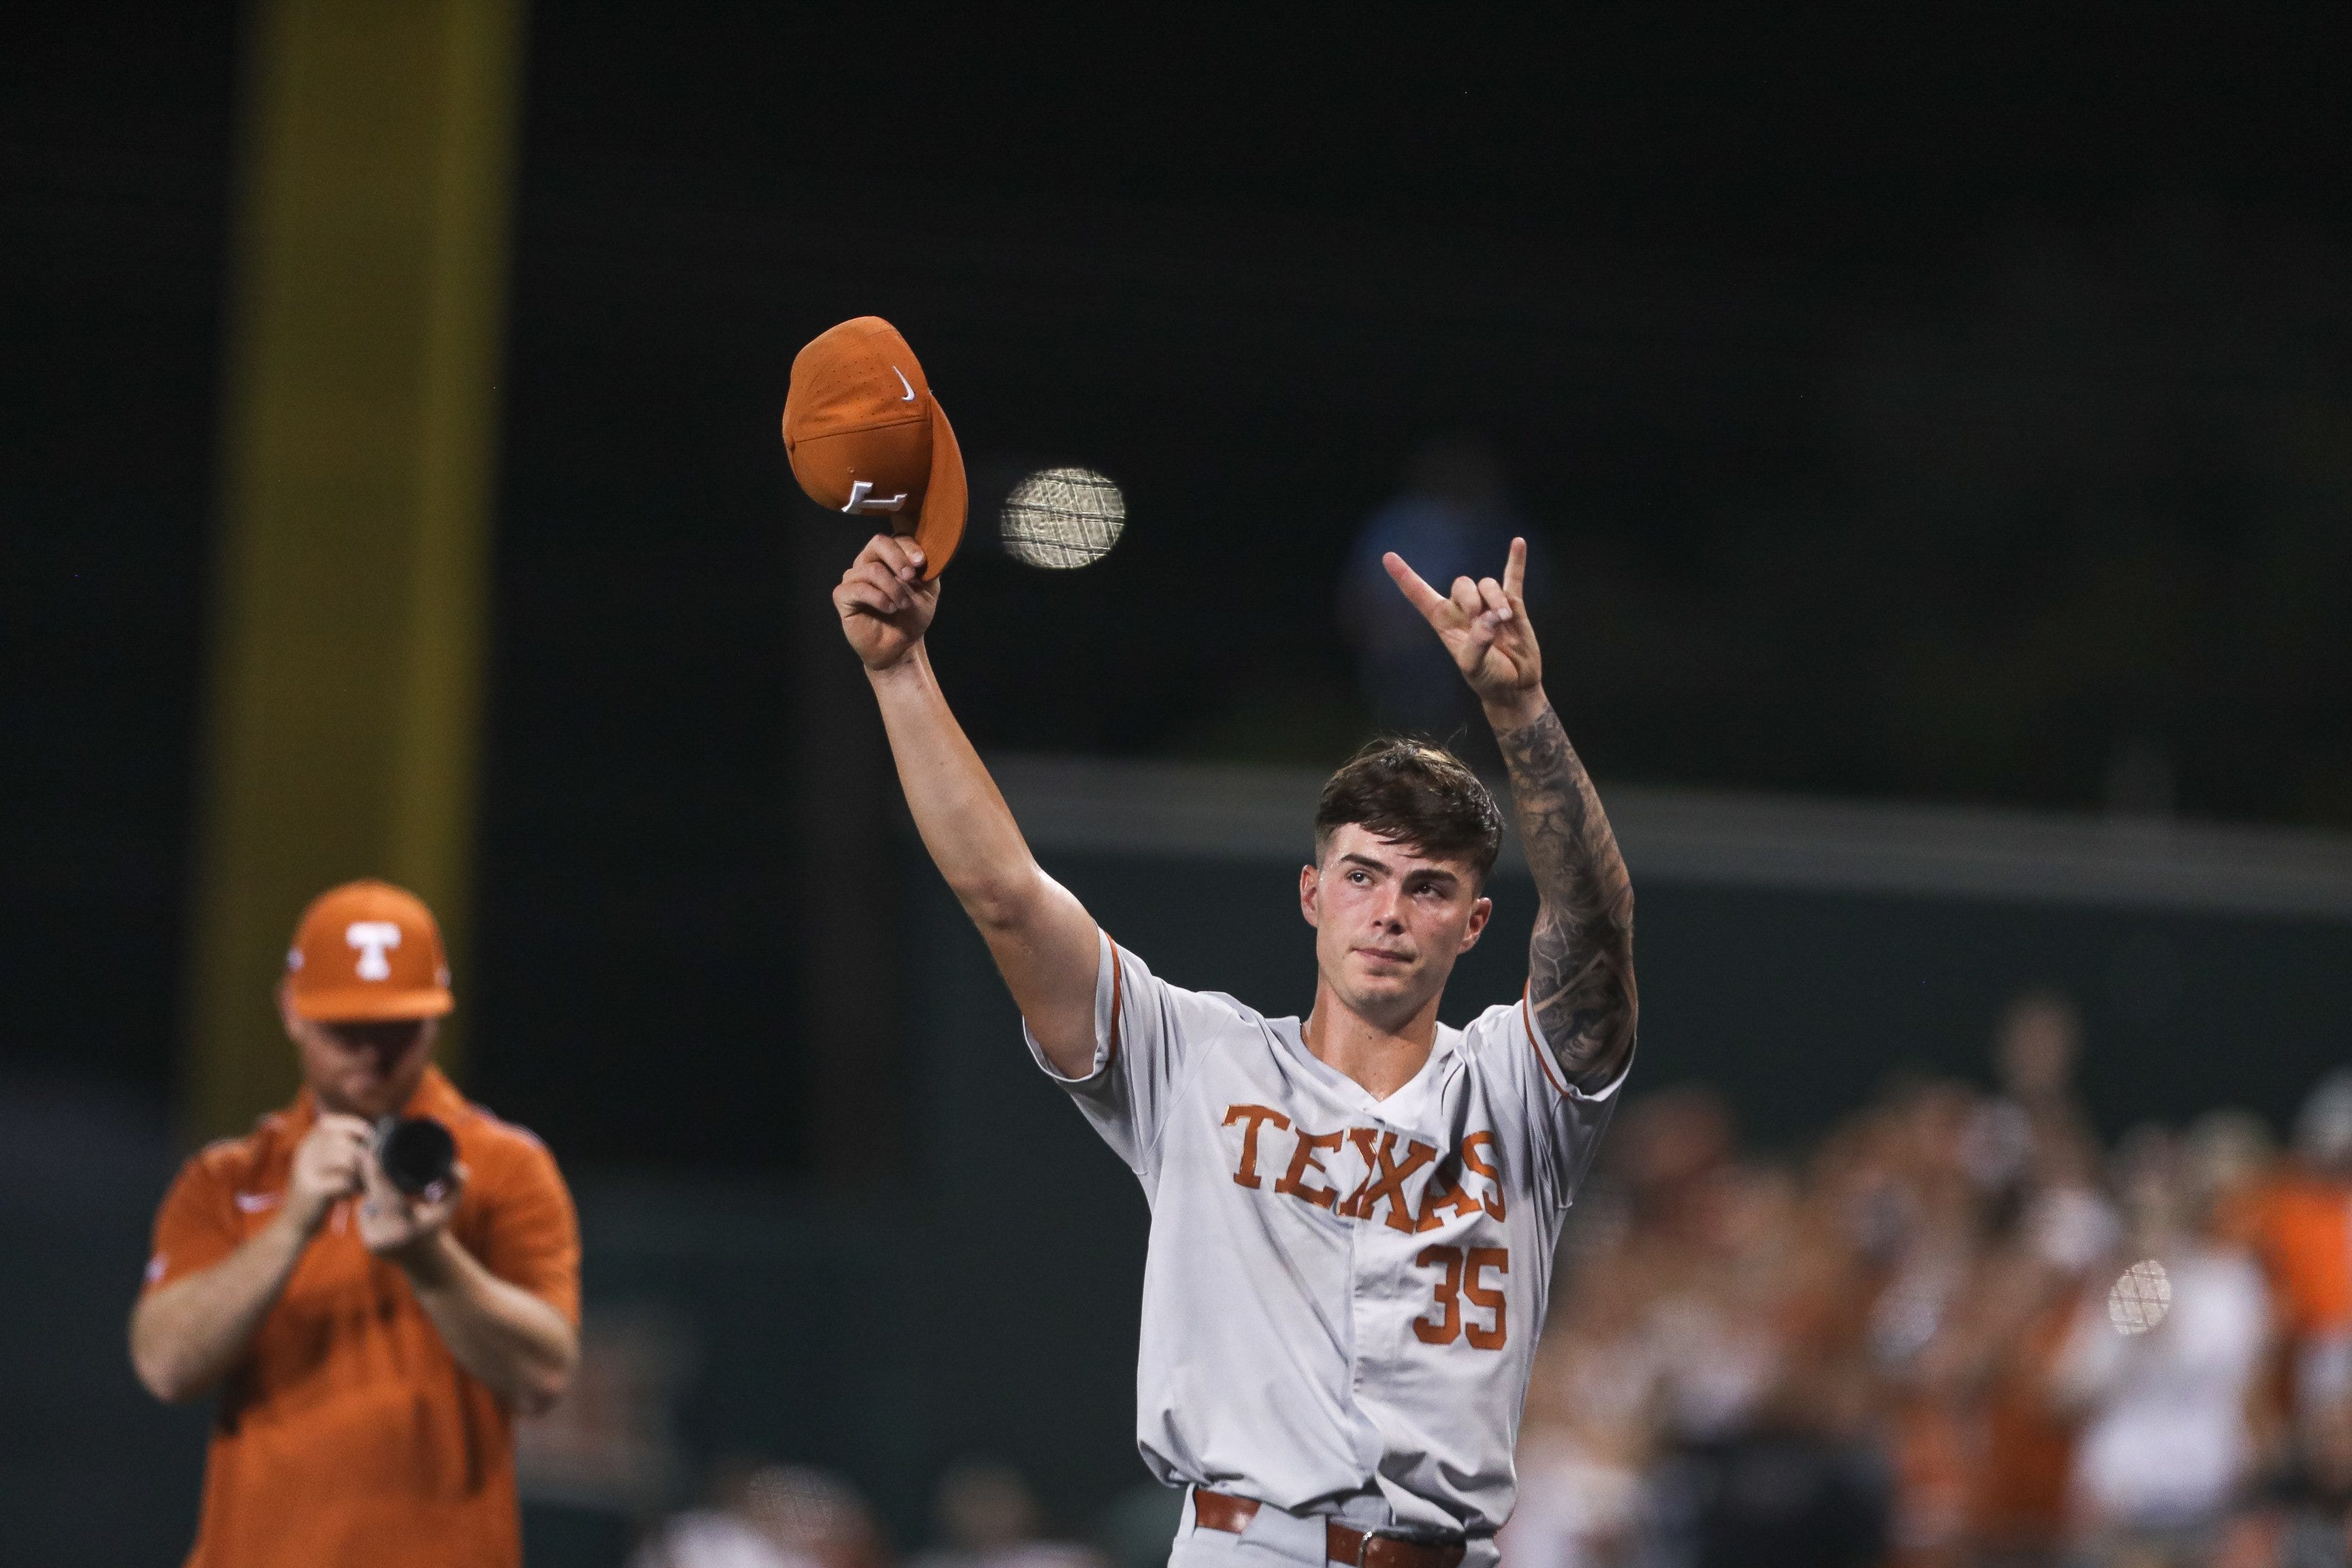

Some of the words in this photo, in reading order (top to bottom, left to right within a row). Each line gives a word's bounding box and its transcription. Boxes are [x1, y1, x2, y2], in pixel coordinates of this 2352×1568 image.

[346, 921, 402, 981] T
[1222, 1103, 1506, 1234] TEXAS
[1413, 1244, 1509, 1350] 35
